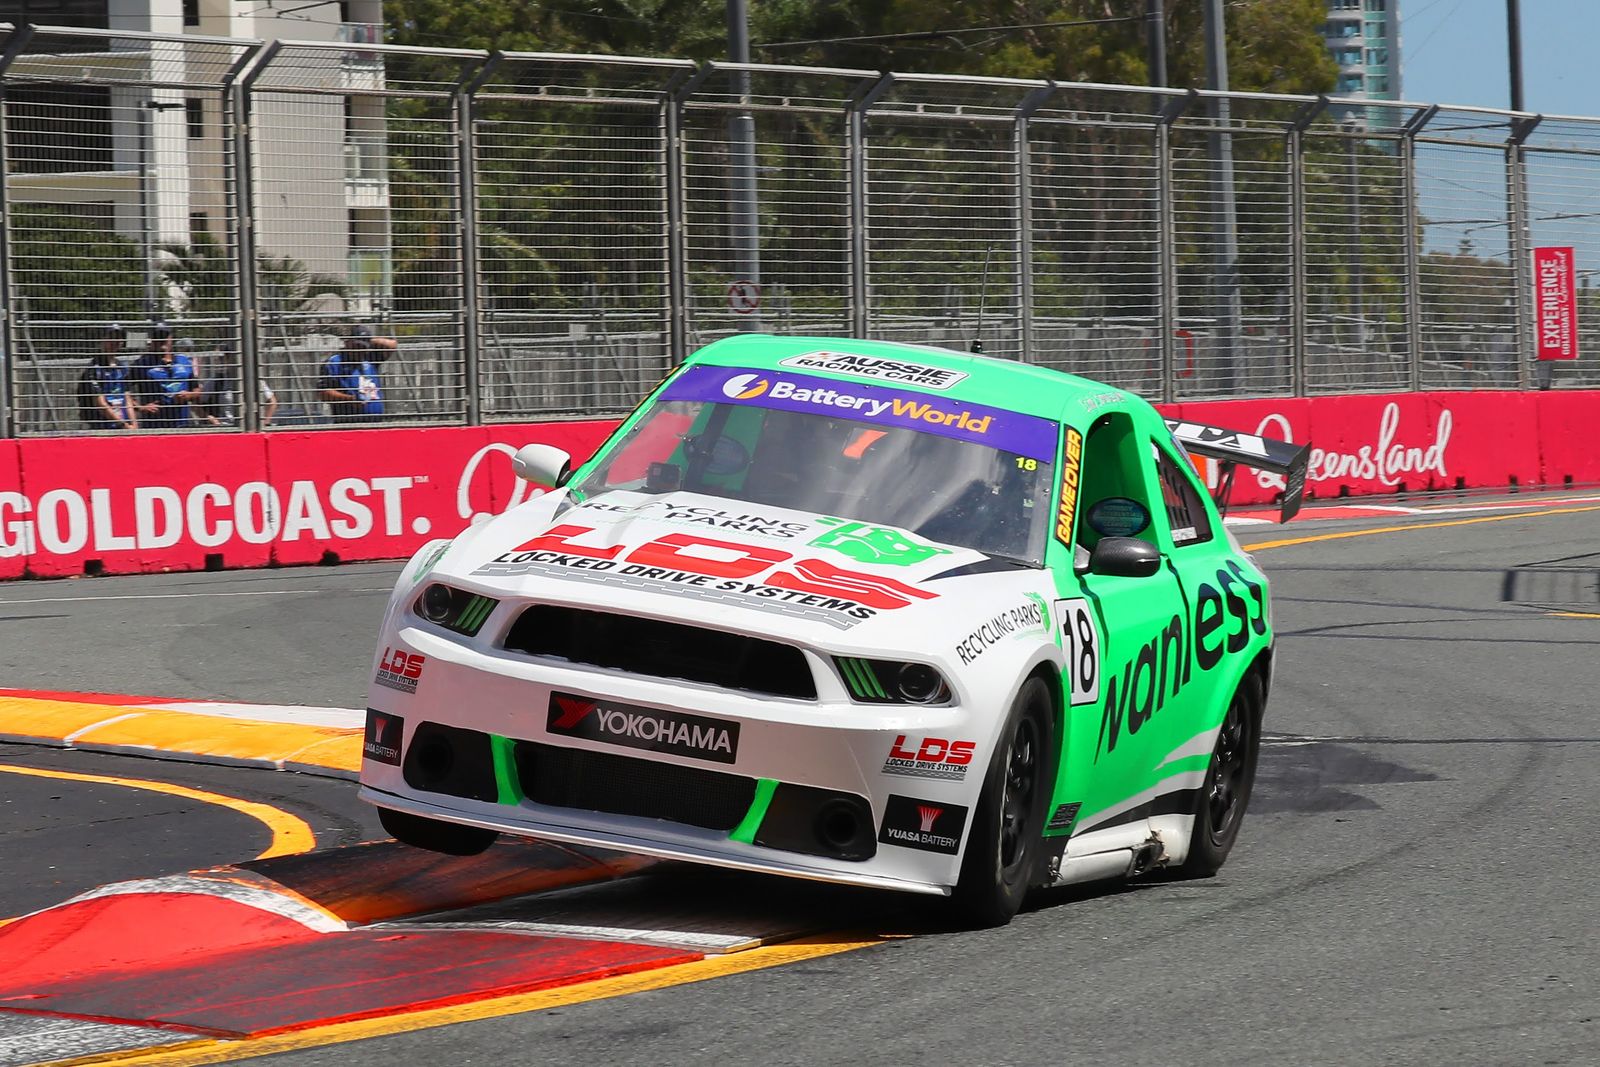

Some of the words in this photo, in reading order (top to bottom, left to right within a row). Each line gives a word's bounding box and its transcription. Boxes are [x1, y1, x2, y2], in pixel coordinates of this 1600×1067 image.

[1541, 259, 1560, 348] EXPERIENCE
[797, 359, 878, 376] RACING
[885, 371, 943, 387] CARS
[833, 355, 957, 380] AUSSIE
[1015, 457, 1037, 471] 18
[582, 502, 809, 532] RECYCLING
[664, 512, 800, 538] PARKS
[510, 524, 941, 610] LDS
[492, 551, 617, 571] LOCKED
[618, 564, 715, 586] DRIVE
[716, 580, 877, 620] SYSTEMS
[956, 612, 1015, 666] RECYCLING
[1010, 603, 1042, 630] PARKS
[379, 646, 425, 678] LDS
[1063, 608, 1096, 693] 18
[596, 707, 732, 753] YOKOHAMA
[888, 735, 976, 764] LDS
[886, 758, 914, 768] LOCKED
[916, 761, 937, 770] DRIVE
[937, 763, 968, 773] SYSTEMS
[887, 828, 920, 842] YUASA
[921, 834, 958, 848] BATTERY
